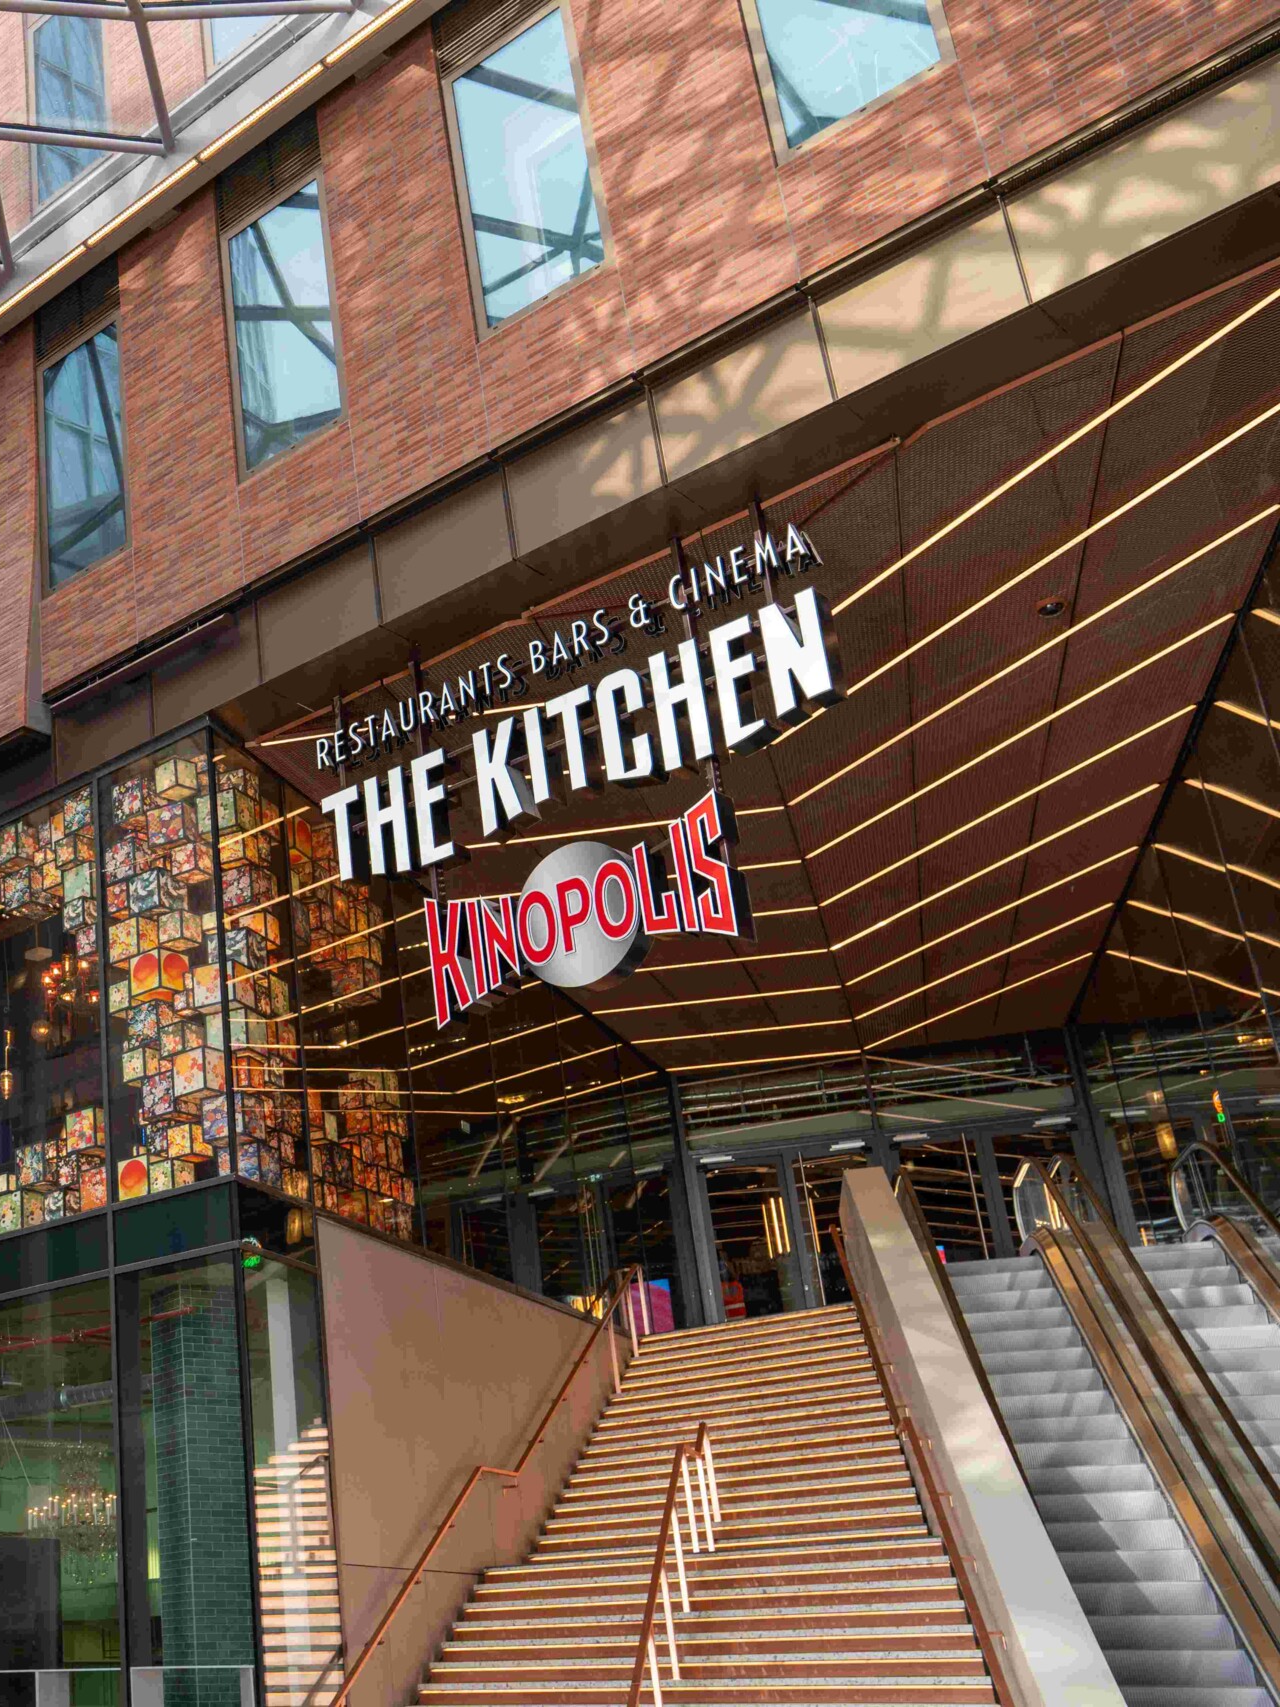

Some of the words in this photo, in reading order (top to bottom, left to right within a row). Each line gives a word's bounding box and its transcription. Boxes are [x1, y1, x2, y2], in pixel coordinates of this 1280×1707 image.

[316, 654, 513, 770] RESTAURANTS
[529, 609, 609, 675] BARS
[629, 594, 651, 628] &
[670, 522, 808, 611] CINEMA
[322, 748, 455, 882] THE
[472, 586, 834, 838] KITCHEN
[423, 787, 739, 1031] KINOPOLIS
